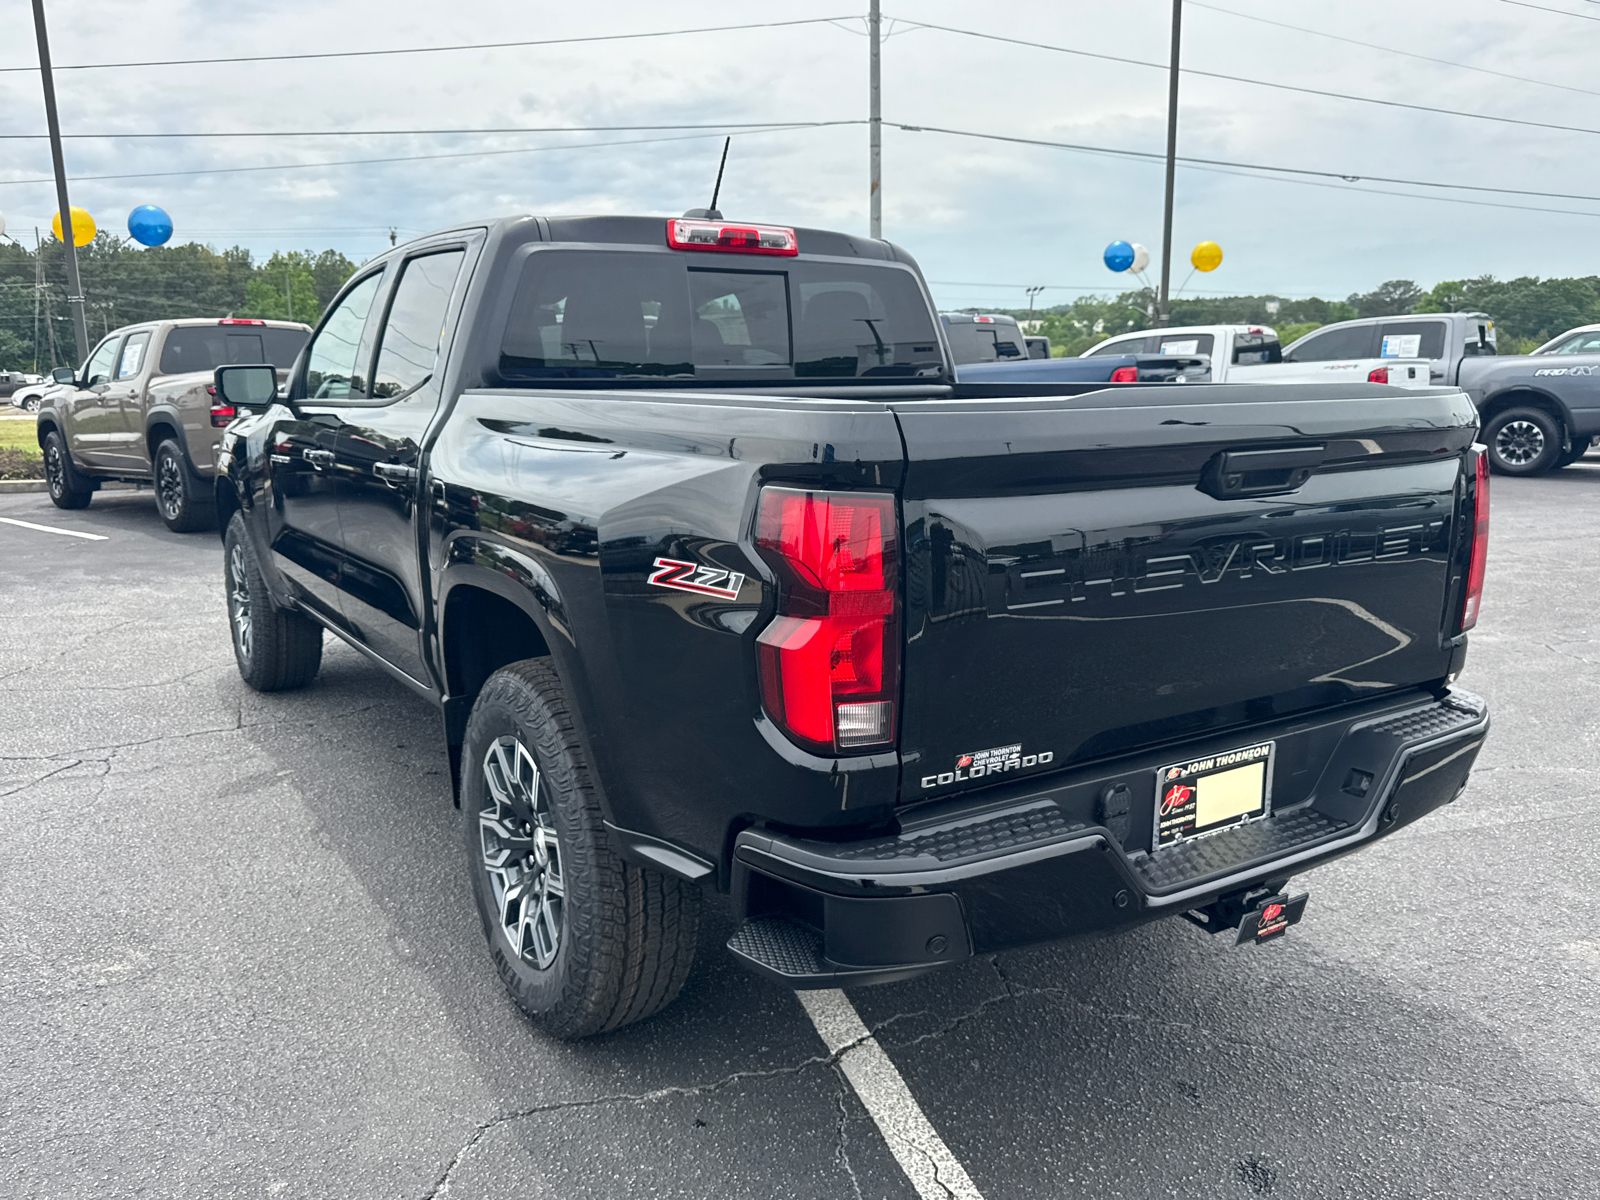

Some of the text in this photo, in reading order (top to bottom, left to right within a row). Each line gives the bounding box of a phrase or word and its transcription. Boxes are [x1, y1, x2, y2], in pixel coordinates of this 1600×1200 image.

[647, 557, 745, 601] Z71
[1006, 520, 1445, 610] CHEVROLET
[921, 751, 1054, 789] COLORADO
[973, 754, 1009, 767] CHEVROLET
[974, 745, 1022, 761] JOHN THORNTON
[1185, 758, 1215, 775] JOHN
[1215, 745, 1270, 767] THORNTON
